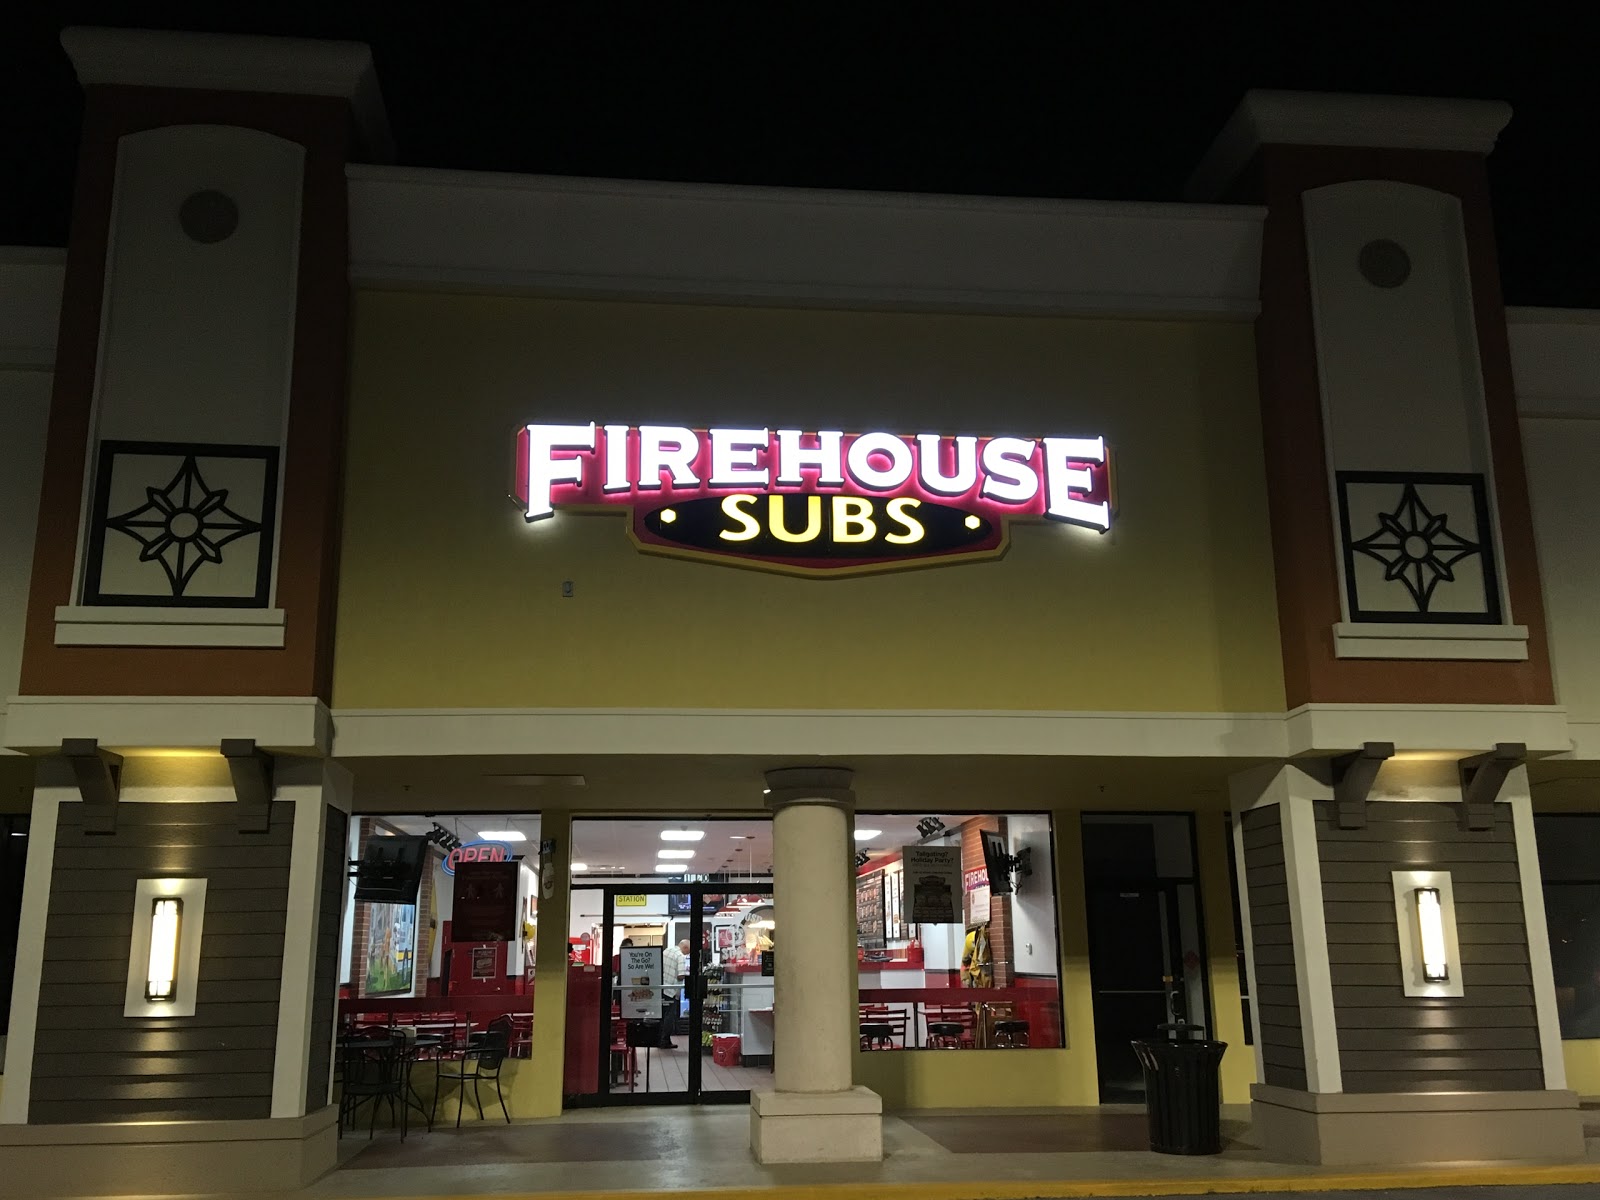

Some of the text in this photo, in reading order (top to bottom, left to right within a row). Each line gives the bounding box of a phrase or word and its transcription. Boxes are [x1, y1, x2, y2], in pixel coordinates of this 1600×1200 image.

[524, 421, 1111, 533] FIREHOUSE
[719, 494, 925, 544] SUBS
[447, 847, 505, 869] OPEN
